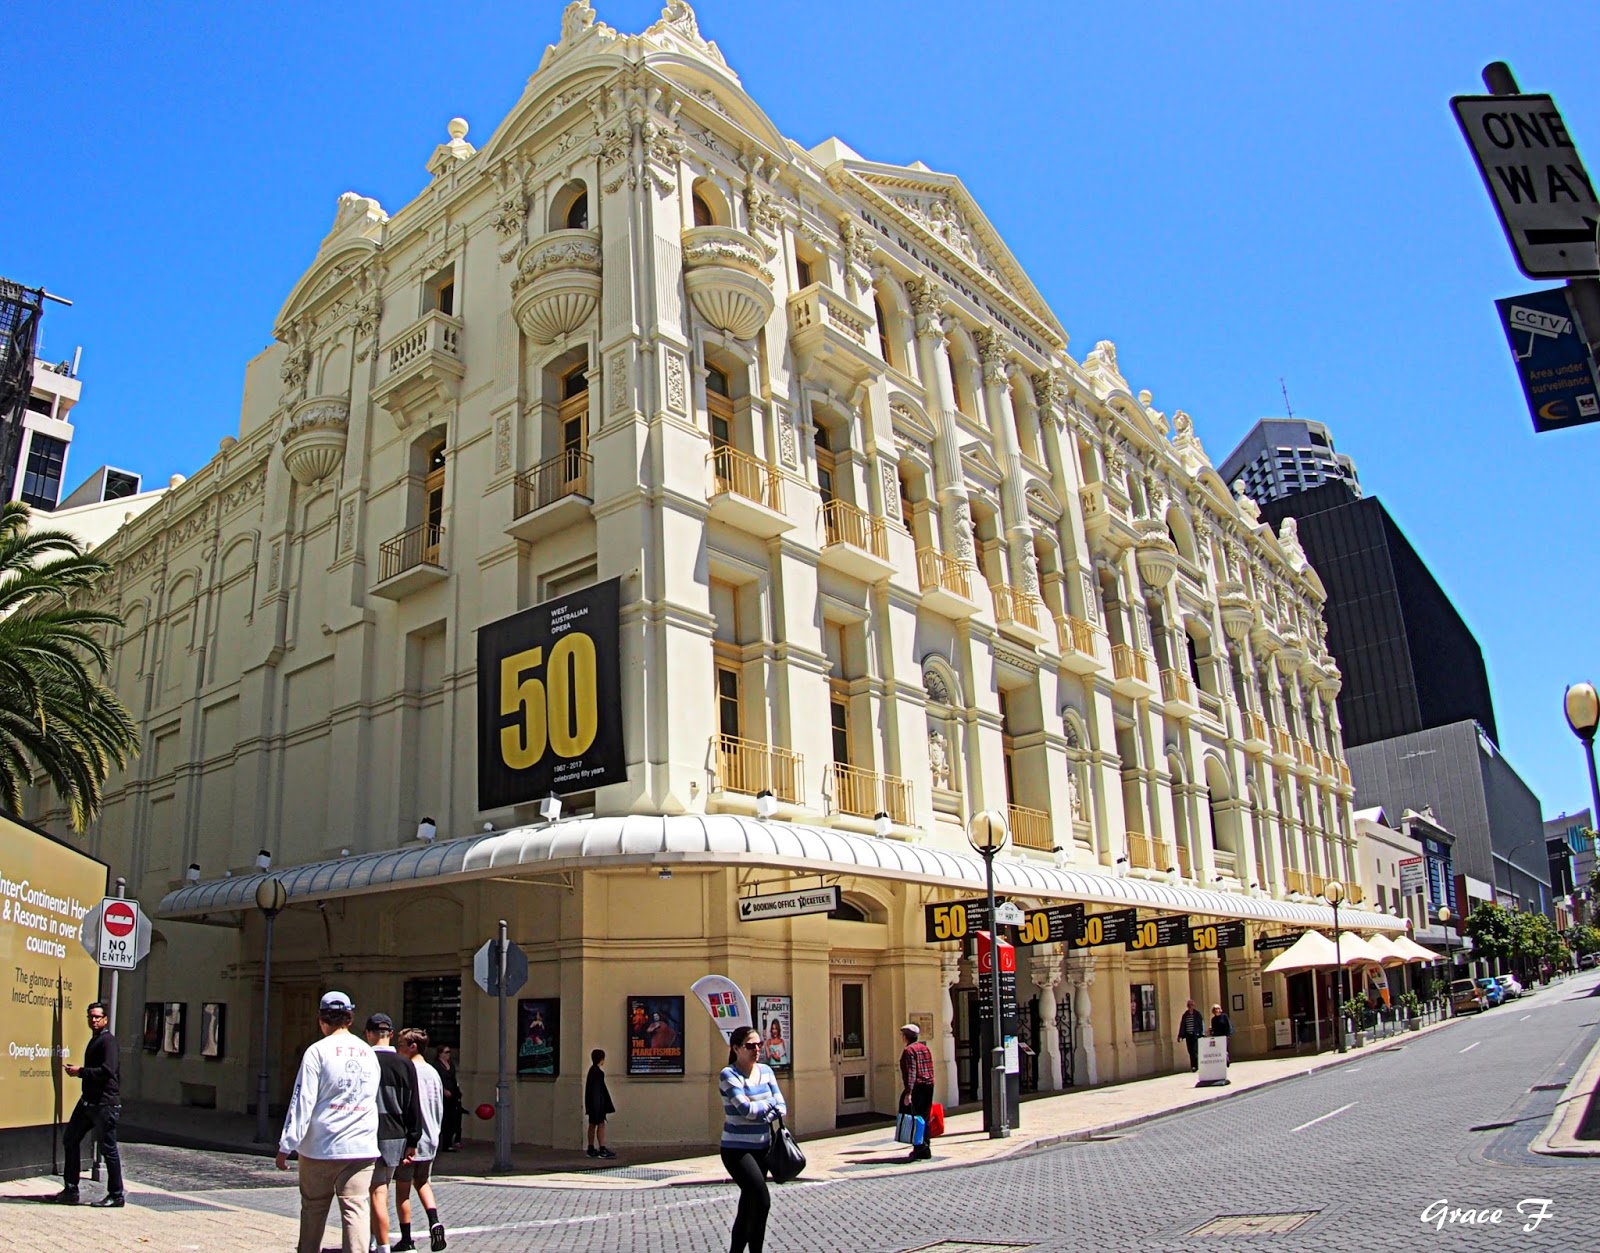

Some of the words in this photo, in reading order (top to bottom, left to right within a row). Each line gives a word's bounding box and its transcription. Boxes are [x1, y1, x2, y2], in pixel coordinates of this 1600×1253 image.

[1482, 112, 1576, 149] ONE
[1495, 164, 1598, 204] WAY
[861, 210, 890, 238] HIS
[897, 237, 981, 307] MAJESTY'S
[986, 304, 1043, 355] THEATRE
[1515, 310, 1560, 330] CCTV
[1530, 369, 1554, 380] Area
[1555, 363, 1584, 375] under
[1531, 376, 1591, 394] surveillance
[551, 605, 568, 617] WEST
[551, 607, 589, 625] AUSTRALIAN
[551, 622, 571, 634] OPERA
[501, 632, 598, 770] 50
[553, 772, 581, 783] celebrating
[591, 766, 605, 777] years
[570, 760, 583, 769] 2017
[752, 901, 778, 912] BOOKING
[777, 899, 797, 909] OFFICE
[2, 899, 12, 920] &
[13, 901, 48, 932] Resorts
[49, 914, 58, 935] in
[59, 921, 78, 940] over
[934, 904, 967, 939] 50
[1018, 912, 1049, 943] 50
[109, 939, 127, 952] NO
[1132, 922, 1158, 949] 50
[1193, 927, 1217, 951] 50
[26, 936, 66, 959] countries
[102, 952, 133, 964] ENTRY
[15, 966, 28, 985] The
[29, 970, 54, 989] glamour
[63, 977, 73, 992] the
[12, 987, 62, 1009] InterContinen
[64, 996, 73, 1010] life
[769, 1003, 790, 1012] LIBERTY
[9, 1041, 35, 1060] Opening
[35, 1043, 49, 1058] Soon
